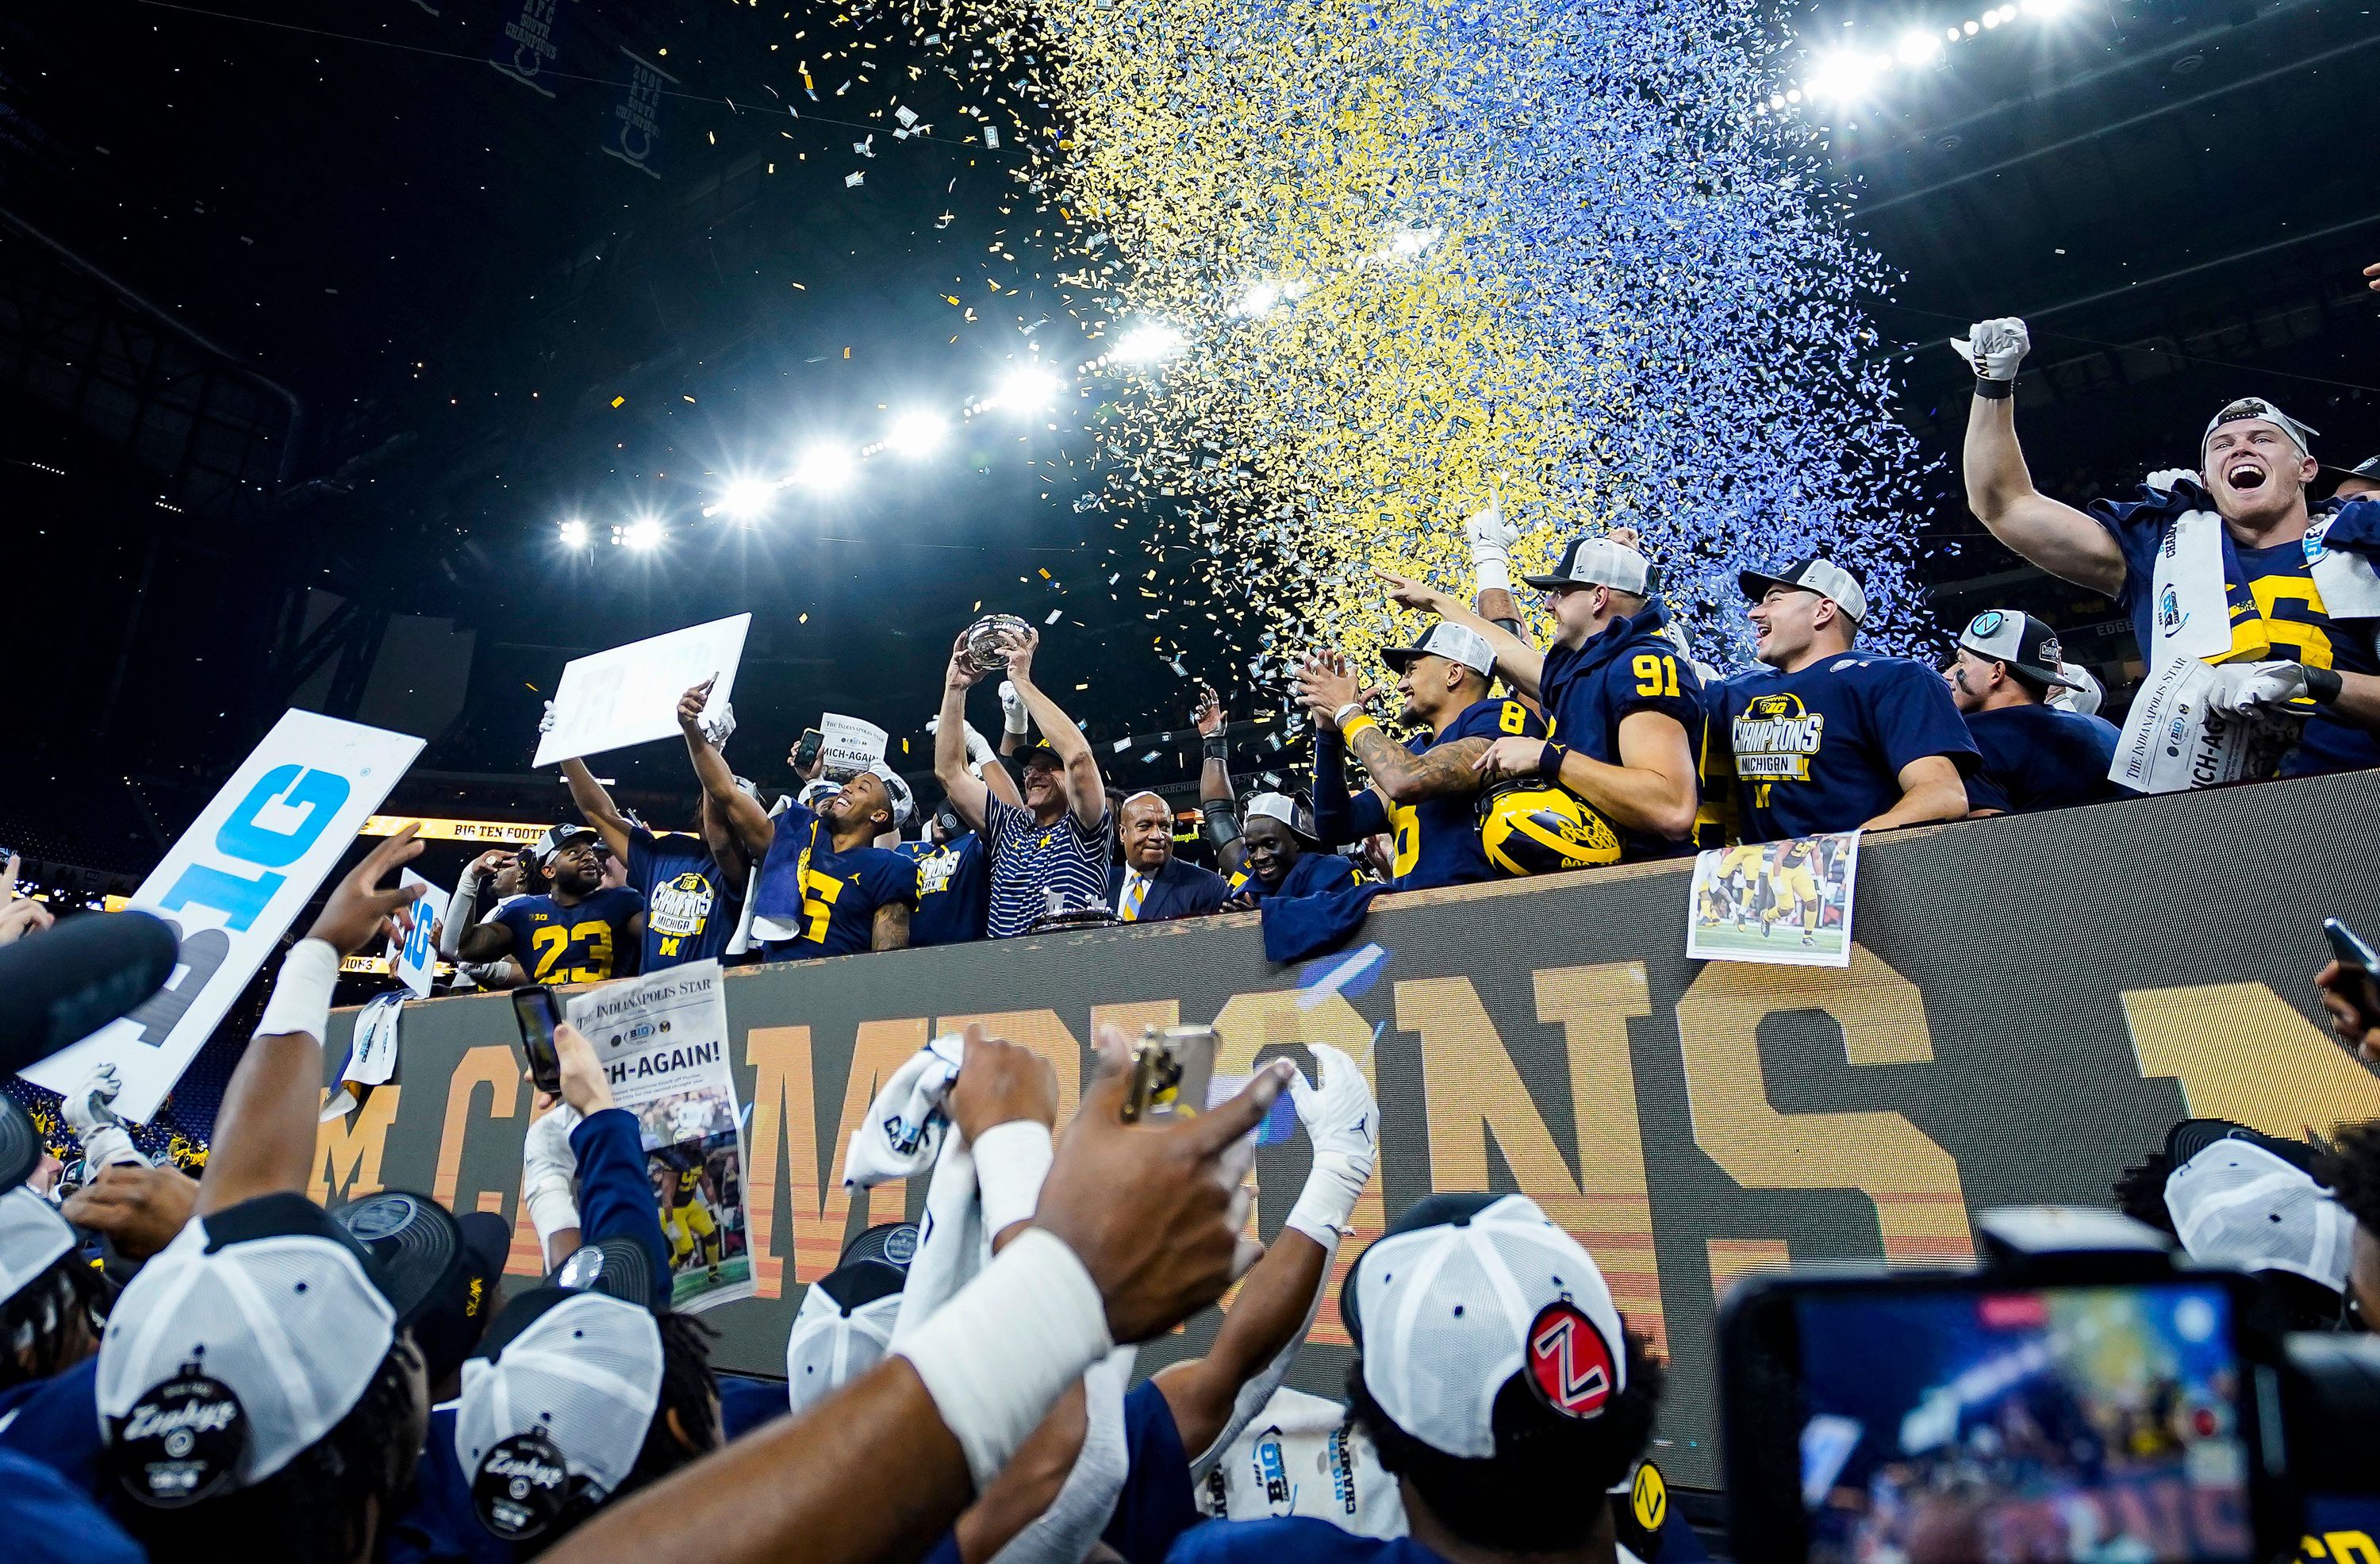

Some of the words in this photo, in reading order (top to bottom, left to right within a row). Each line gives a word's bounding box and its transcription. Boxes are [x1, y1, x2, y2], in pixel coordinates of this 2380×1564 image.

[1632, 655, 1680, 697] 91
[1499, 701, 1527, 735] 8
[1733, 715, 1822, 753] CHAMPIONS
[2125, 759, 2142, 779] THE
[2135, 683, 2167, 758] INDIANAPOLIS
[2161, 657, 2186, 686] STAR
[455, 824, 476, 836] BIG
[480, 825, 504, 837] TEN
[657, 915, 691, 931] MICHIGA
[532, 920, 612, 984] 23
[659, 937, 680, 957] M
[679, 978, 712, 996] STAR
[602, 1040, 721, 1086] H-AGAIN!
[1533, 1316, 1610, 1408] Z
